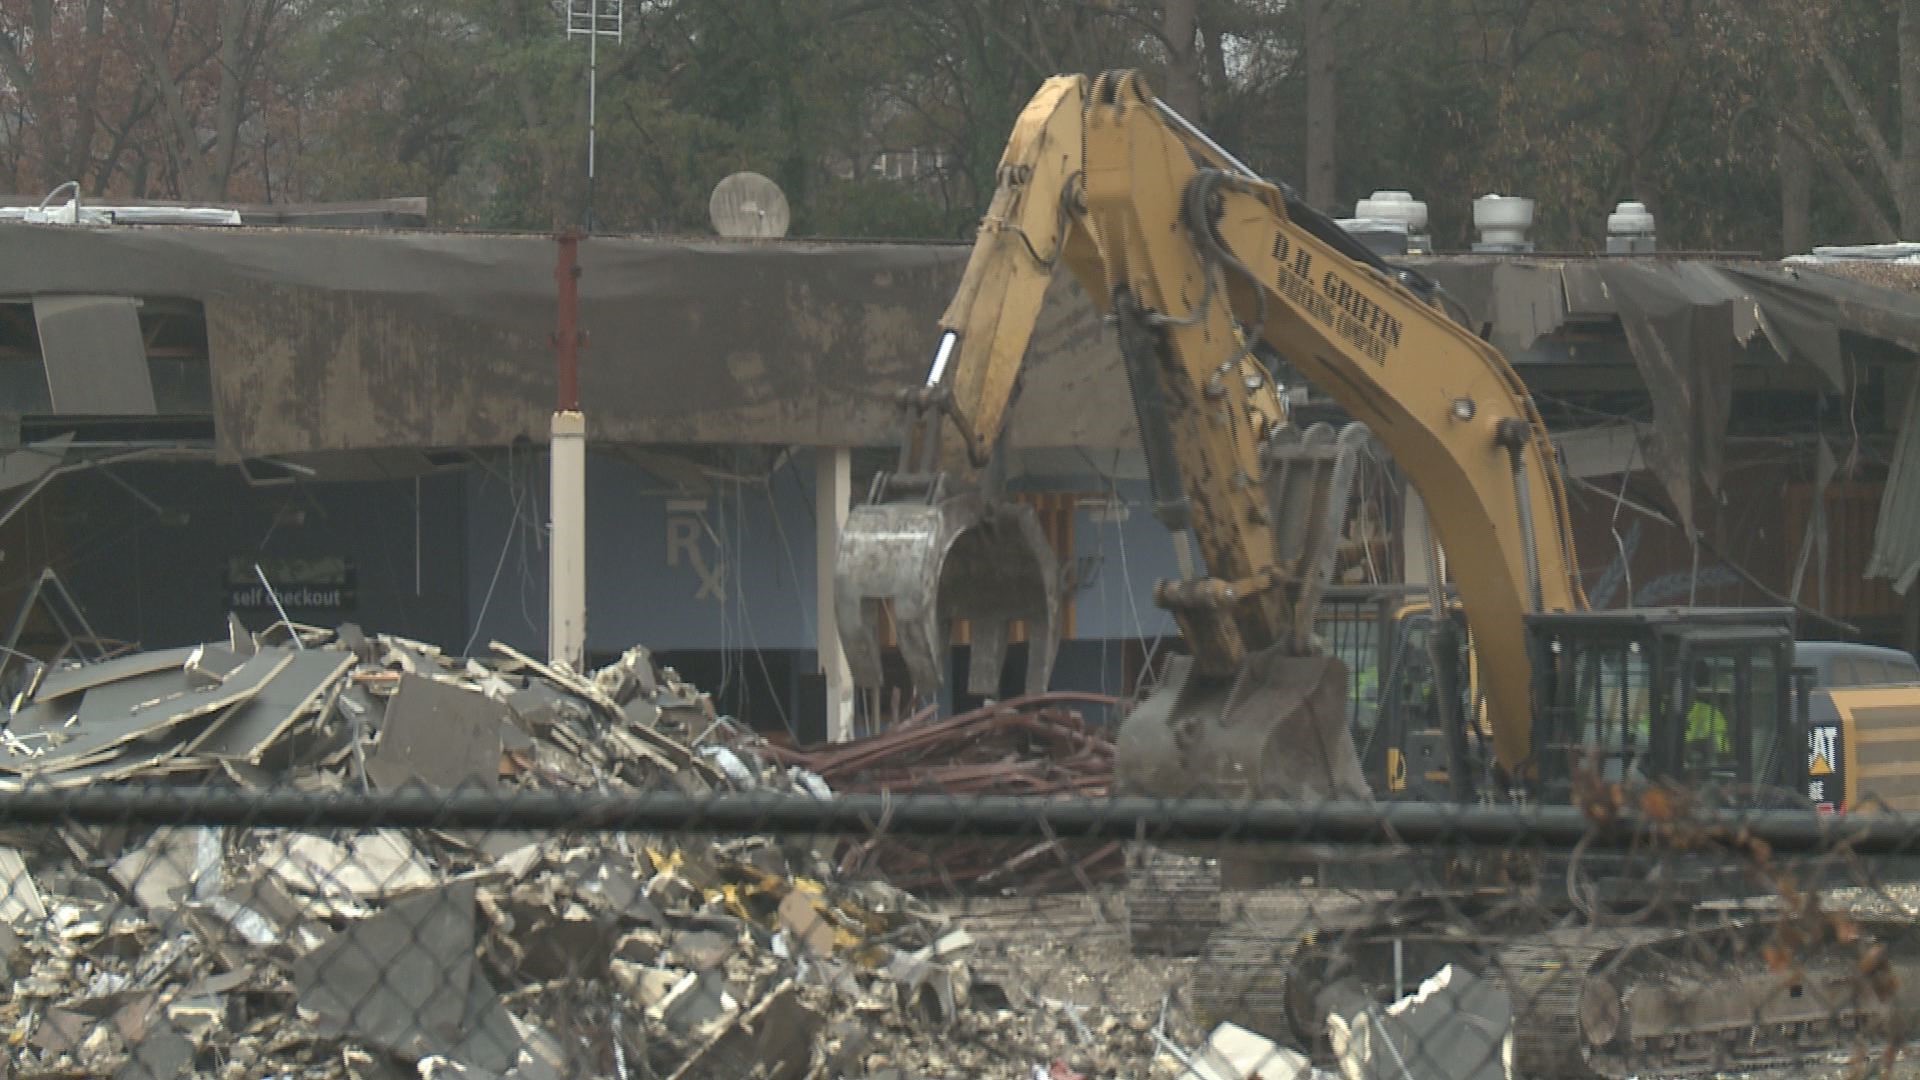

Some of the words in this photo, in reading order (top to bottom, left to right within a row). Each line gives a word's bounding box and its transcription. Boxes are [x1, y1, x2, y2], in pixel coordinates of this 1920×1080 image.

[1277, 265, 1335, 328] WRECKING
[1335, 311, 1388, 368] COMPANY
[1323, 271, 1403, 348] GRIFFIN
[232, 587, 262, 606] self
[266, 587, 341, 607] checkout
[1807, 726, 1838, 774] AT
